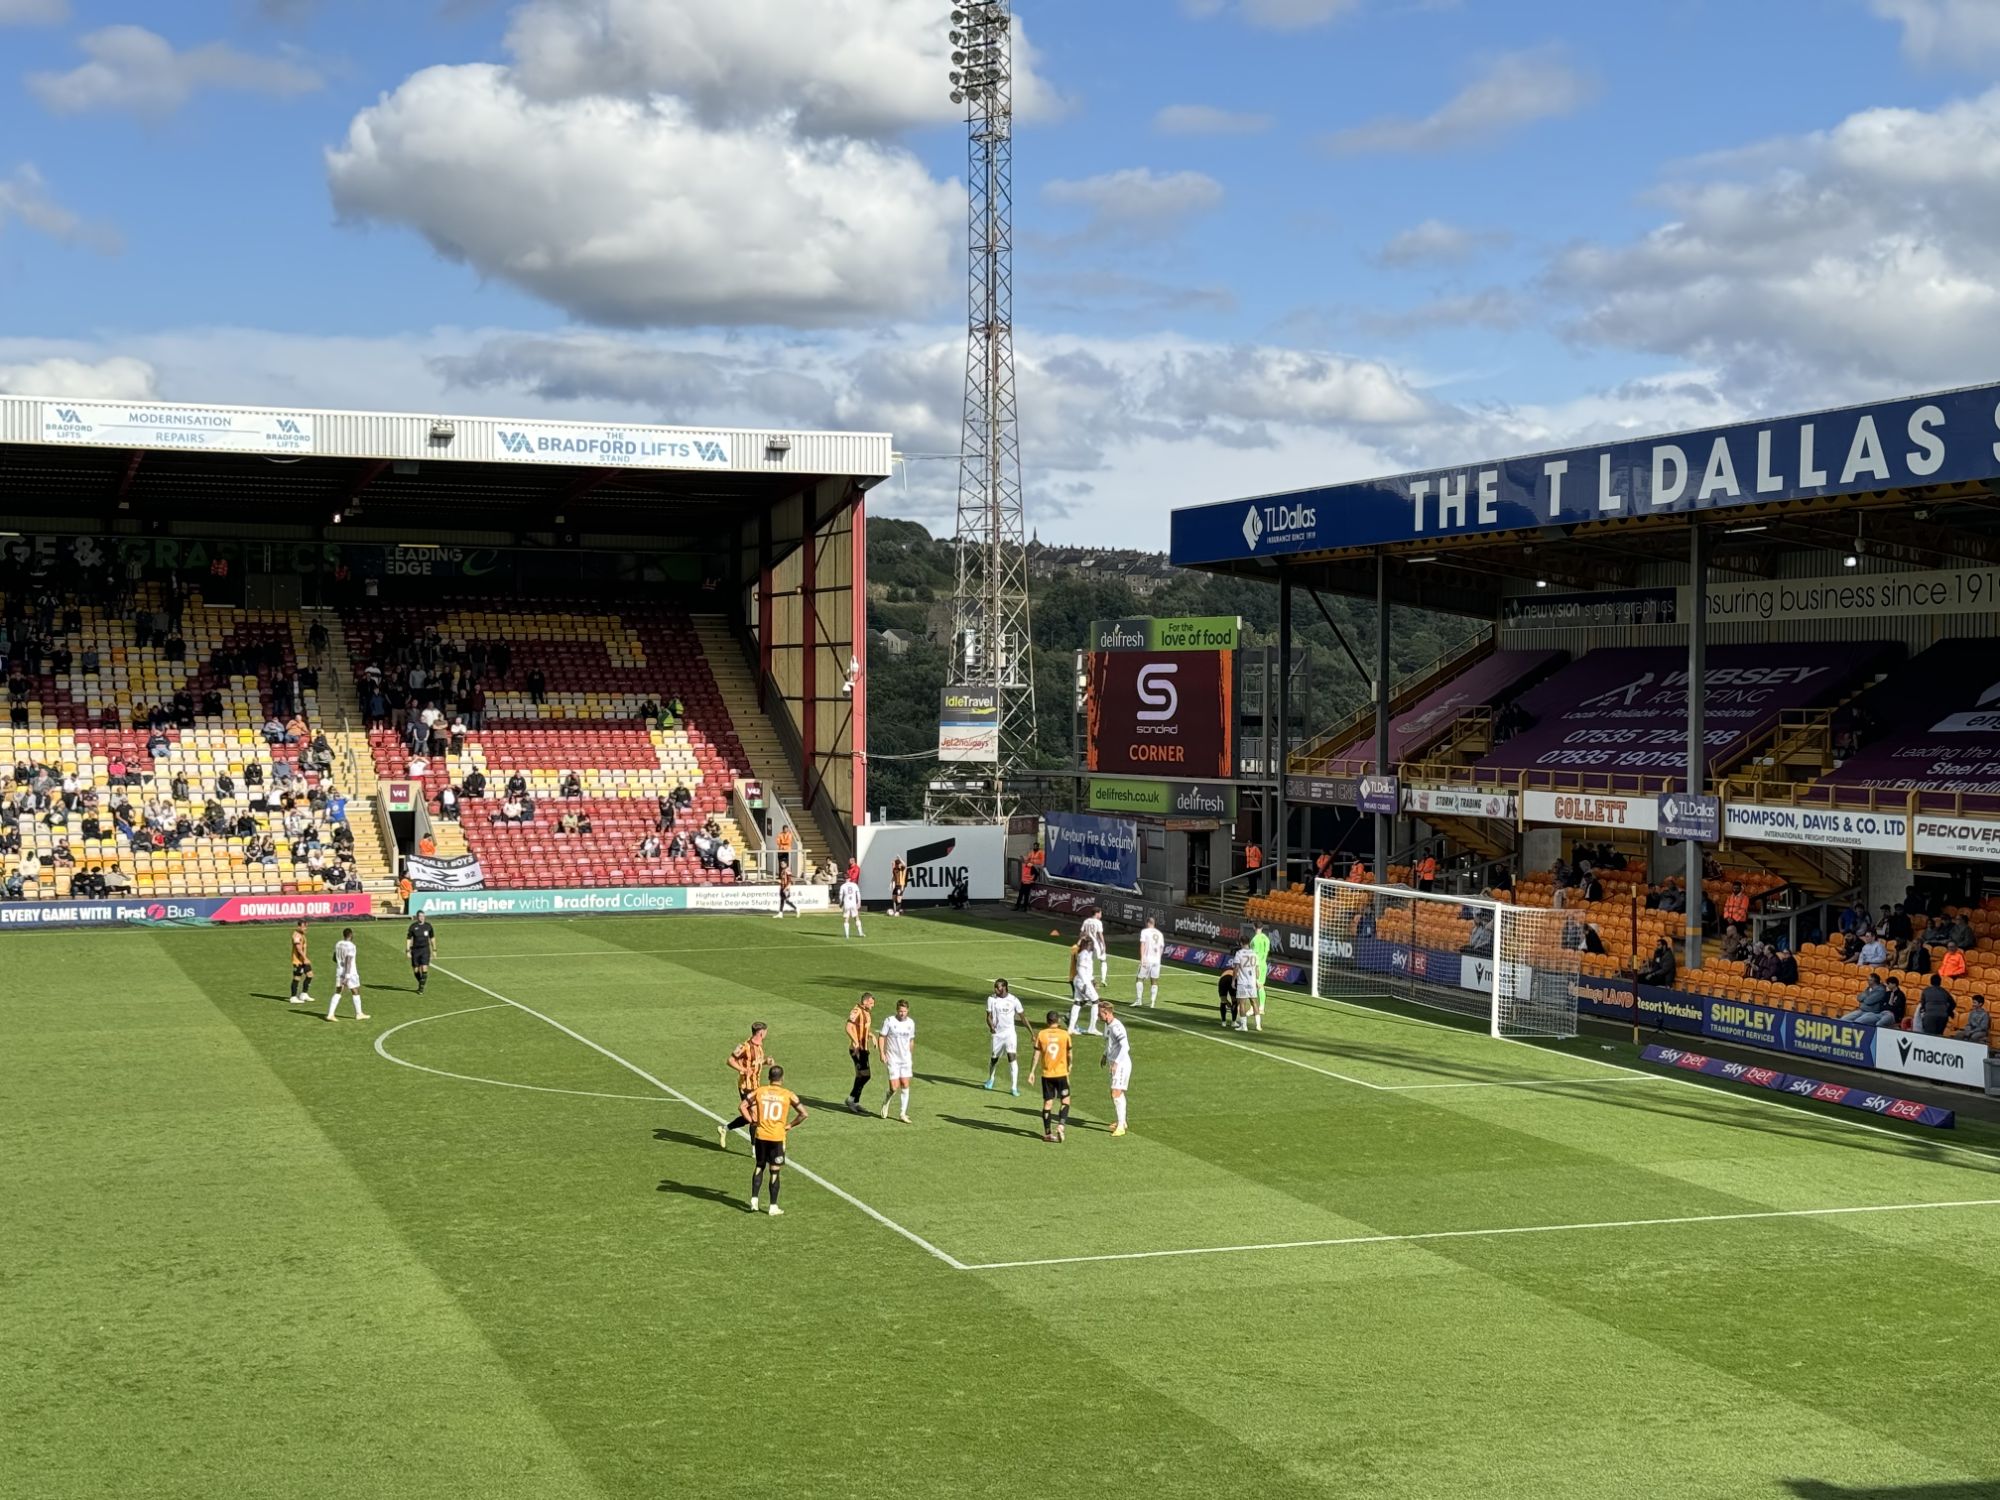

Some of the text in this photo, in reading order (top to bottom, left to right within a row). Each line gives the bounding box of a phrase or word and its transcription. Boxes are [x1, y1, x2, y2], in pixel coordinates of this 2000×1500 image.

[45, 424, 93, 433] BRADFORD
[129, 412, 231, 427] MODERNISATION
[57, 431, 81, 440] LIFTS
[156, 432, 205, 443] REPAIRS
[266, 433, 310, 442] BRADFORD
[606, 432, 624, 440] THE
[277, 441, 300, 449] LIFTS
[538, 437, 690, 457] BRADFORD LIFTS
[600, 454, 630, 463] STAND
[1410, 469, 1498, 532] THE
[1544, 460, 1568, 517] T
[1598, 454, 1621, 511] L
[1651, 405, 1946, 505] DALLAS
[1292, 533, 1305, 542] SINCE
[385, 547, 463, 563] LEADING
[385, 562, 432, 576] EDGE
[1706, 572, 2000, 619] nsuring business since 191
[1624, 599, 1675, 620] graphics
[1169, 622, 1193, 633] For the
[1100, 628, 1144, 649] delifresh
[1162, 628, 1231, 646] love of food
[1563, 729, 1741, 746] 07535 72488
[1129, 744, 1185, 763] CORNER
[1536, 750, 1617, 766] 07835
[1891, 745, 1962, 761] Leading
[1961, 746, 1992, 759] the
[1926, 762, 1981, 776] Steel
[1893, 779, 1939, 791] Fluid
[1096, 787, 1160, 805] delifresh.co.uk
[1177, 792, 1224, 812] delifresh
[1435, 796, 1482, 810] STORM TRADING
[1554, 796, 1628, 824] COLLETT
[1727, 807, 1799, 831] THOMPSON,
[1803, 814, 1839, 831] DAVIS
[1844, 816, 1854, 833] &
[1856, 817, 1882, 835] CO.
[1884, 819, 1905, 836] LTD
[1061, 828, 1134, 854] Keybury Fire & Security
[1683, 828, 1712, 839] INSURANCE
[1764, 830, 1862, 845] INTERNATIONAL FREIGHT FORWARDERS
[1968, 845, 1984, 853] GIVE
[450, 855, 474, 868] BOYS
[423, 893, 673, 913] Aim Higher with Bradford College
[695, 892, 719, 901] Higher
[721, 891, 739, 899] Level
[724, 898, 750, 908] Degree
[752, 897, 771, 908] Study
[1, 904, 196, 922] EVERY GAME WITH First Bus
[240, 901, 355, 916] DOWNLOAD OUR APP
[1175, 916, 1220, 939] petherbridge
[1152, 933, 1160, 945] 9
[1193, 949, 1206, 963] sky
[1206, 951, 1219, 964] bet
[1243, 955, 1257, 969] 20
[1392, 949, 1408, 970] sky
[1602, 988, 1635, 1008] LAND
[1637, 996, 1703, 1021] Resort Yorkshire
[1711, 1003, 1775, 1032] SHIPLEY
[1710, 1023, 1775, 1044] TRANSPORT SERVICES
[1795, 1018, 1865, 1048] SHIPLEY
[1047, 1042, 1060, 1061] 9
[1659, 1048, 1705, 1067] sky bet
[1794, 1040, 1864, 1062] TRANSPORT SERVICES
[1913, 1047, 1964, 1069] macron
[1722, 1062, 1773, 1083] sky bet
[1790, 1079, 1844, 1101] sky bet
[762, 1100, 783, 1121] 10
[1863, 1094, 1922, 1118] sky bet
